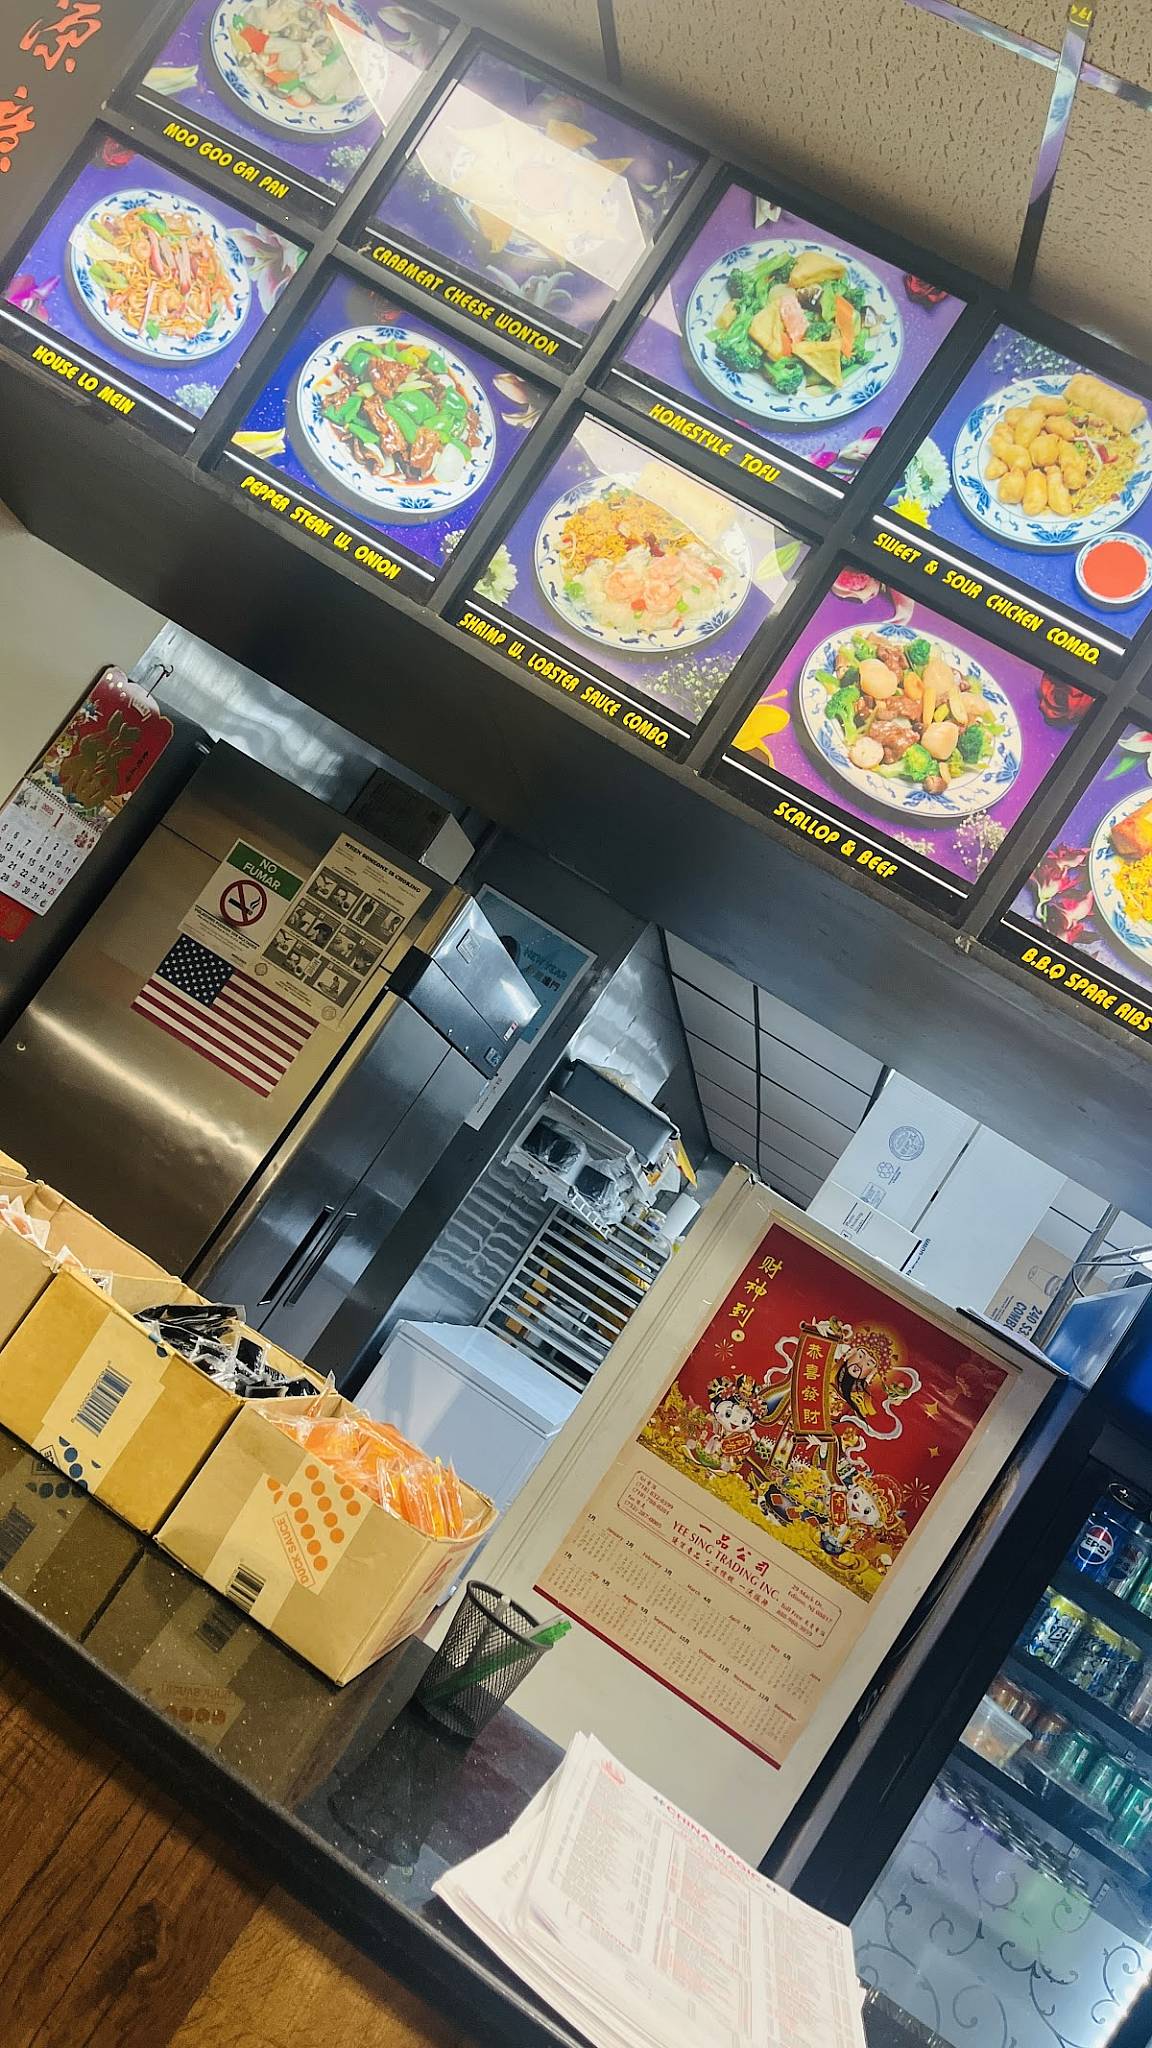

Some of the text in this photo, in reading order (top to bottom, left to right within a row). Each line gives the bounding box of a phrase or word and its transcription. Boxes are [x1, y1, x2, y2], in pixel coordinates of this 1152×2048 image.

[164, 123, 288, 198] MOO GOO GAI PAN
[373, 247, 558, 355] CRABMEAT CHEESE WONTON
[32, 346, 134, 414] HOUSE LO MEIN
[649, 404, 780, 482] HOMESTYLE TOFU
[242, 476, 400, 579] PEPPER STEAK W. ONION
[874, 533, 1099, 664] SWEET & SOUR CHICKEN COMBO.
[459, 613, 668, 748] SHRIMP W. LOBSTER SAUCE COMBO.
[53, 812, 64, 828] 1
[774, 802, 896, 877] SCALLOP & BEEF
[242, 861, 281, 890] FUMAR
[259, 858, 278, 874] NO
[344, 842, 362, 856] WHEN
[360, 852, 389, 873] SOMEONE
[387, 869, 395, 877] IS
[394, 873, 421, 893] CHOKING
[1021, 948, 1152, 1031] B.B.Q SPARE RIBS
[729, 1254, 783, 1328] 财神到
[1025, 1304, 1043, 1324] 240
[802, 1343, 823, 1426] 恭喜發財
[276, 1517, 310, 1584] DUCK SAUCE
[640, 1551, 663, 1569] February
[685, 1582, 702, 1597] March
[670, 1520, 782, 1602] YEE SING TRADING INC.
[699, 1523, 769, 1576] 一品公司
[622, 1593, 639, 1607] August
[651, 1615, 678, 1635] September
[731, 1673, 757, 1692] November
[667, 1805, 761, 1883] CHINA MAGIC
